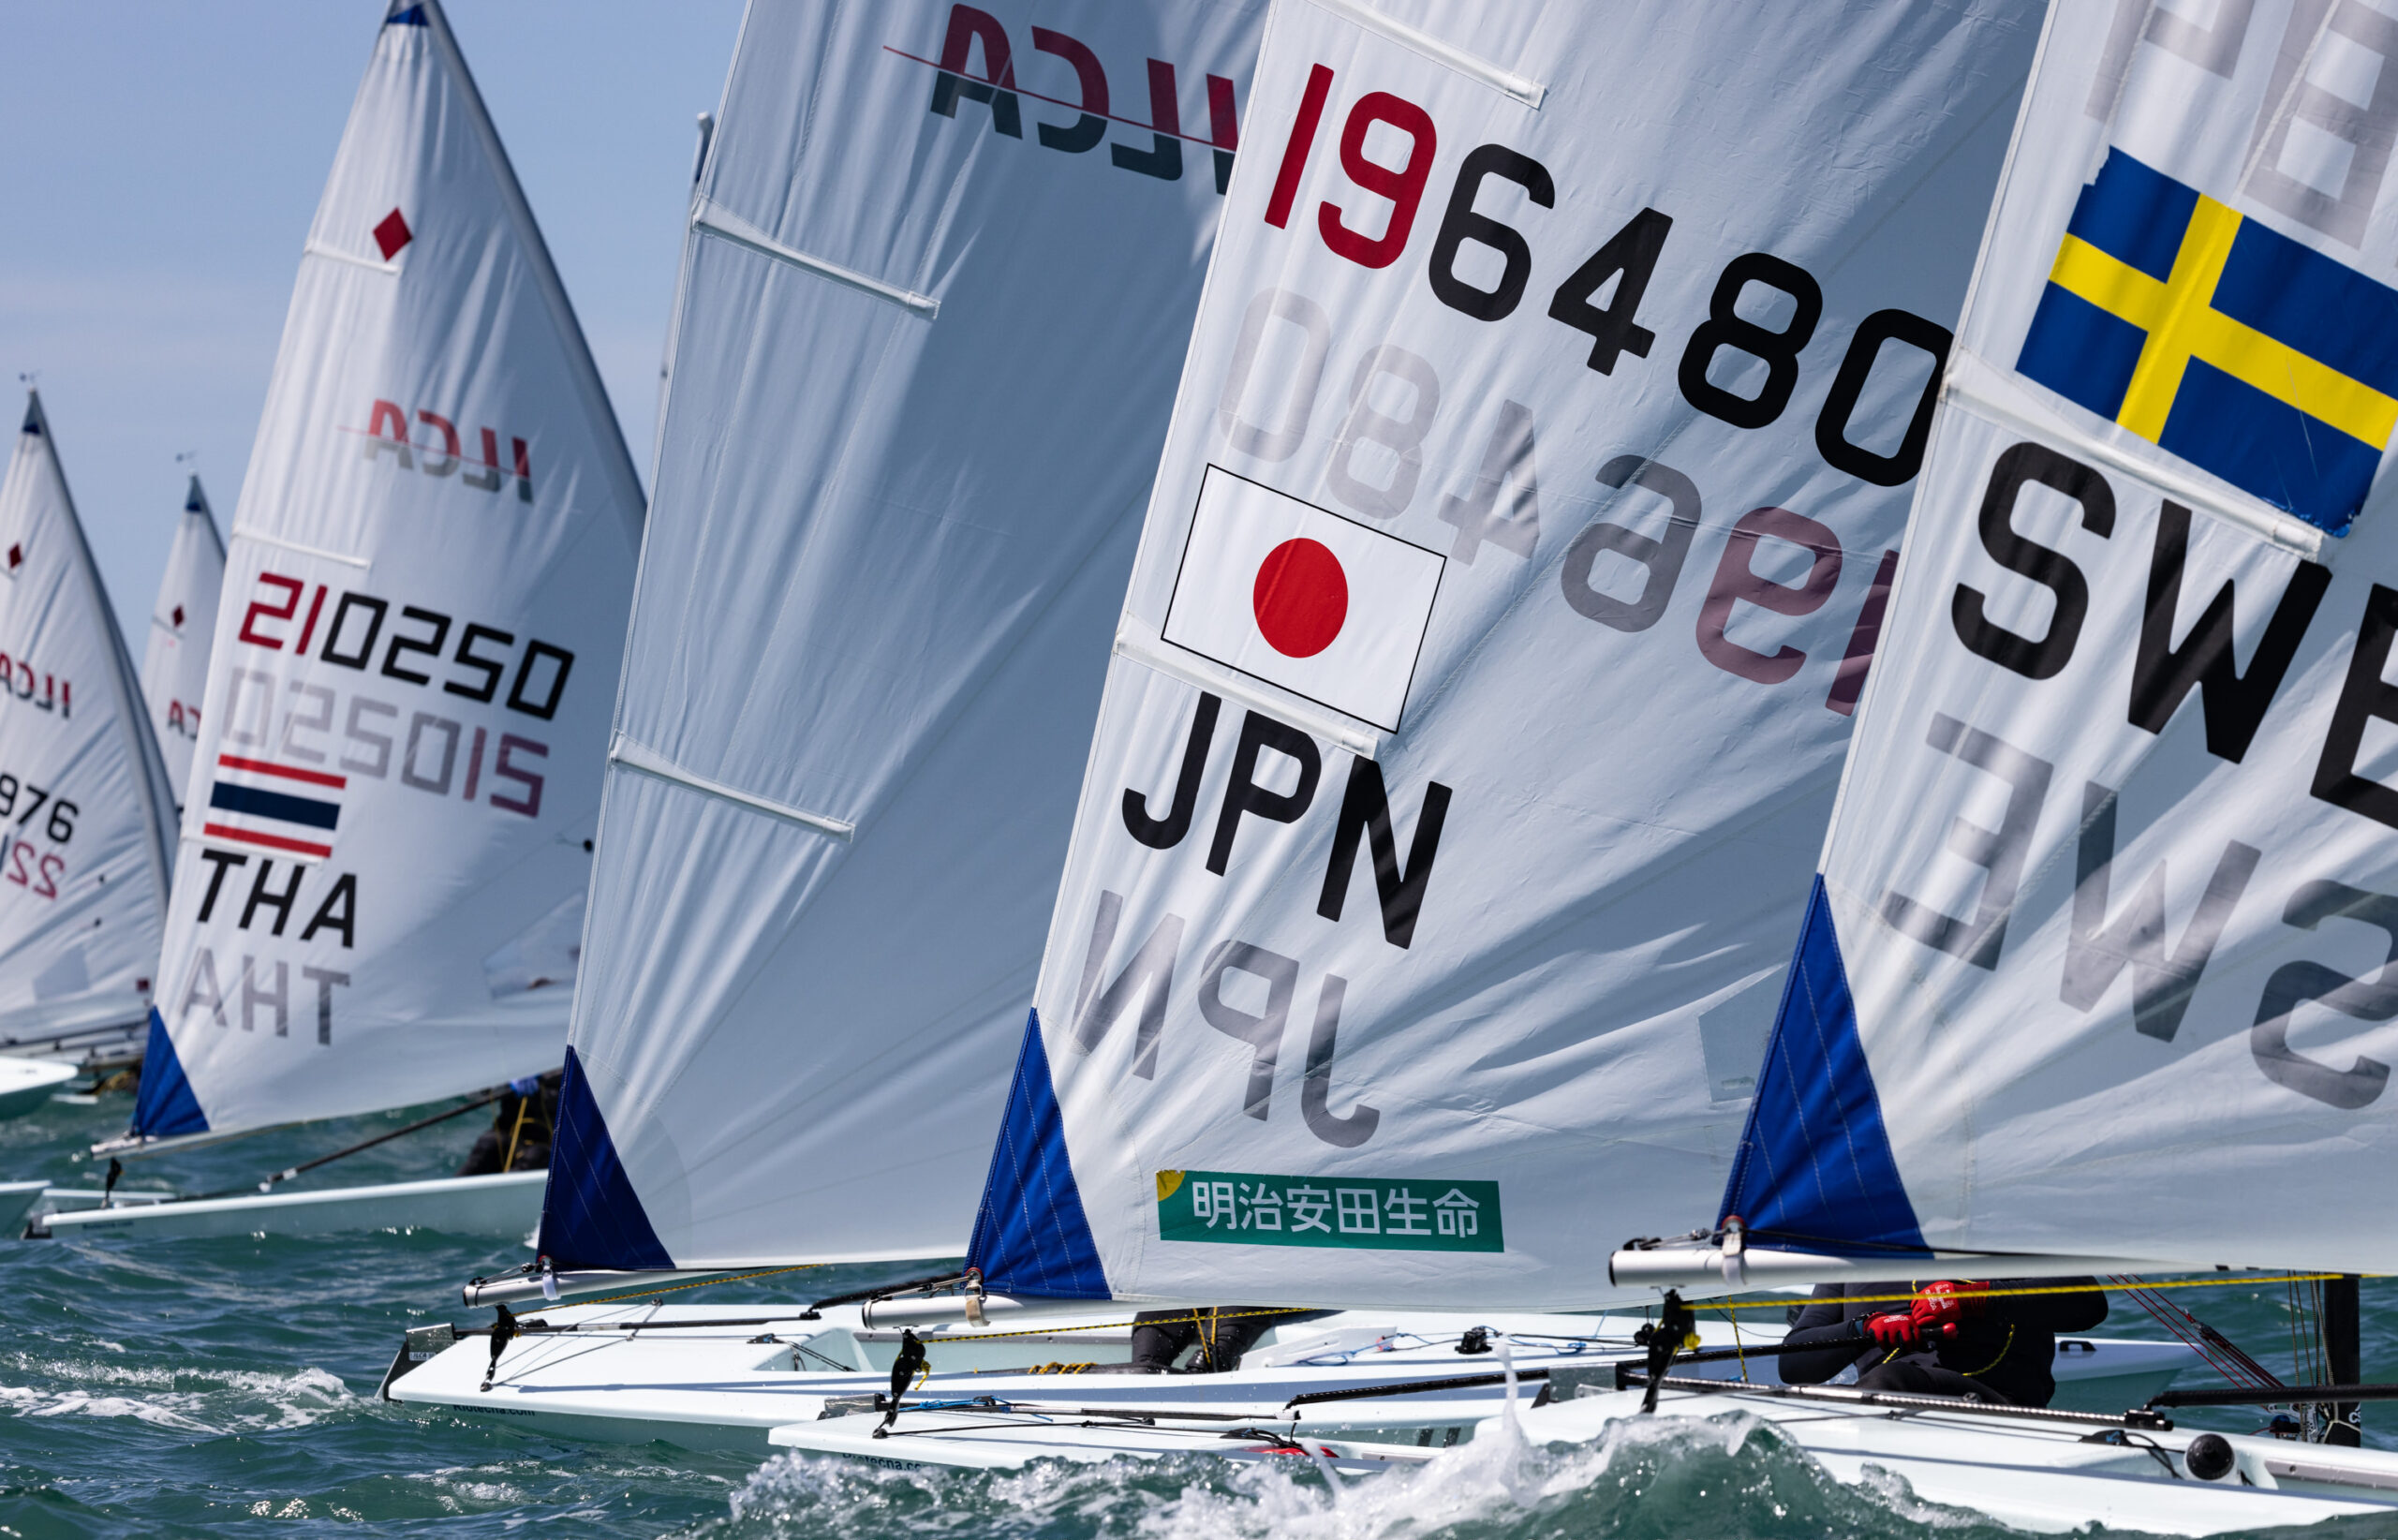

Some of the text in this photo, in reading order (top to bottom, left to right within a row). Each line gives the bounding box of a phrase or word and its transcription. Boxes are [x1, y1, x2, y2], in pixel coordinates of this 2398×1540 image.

[1264, 62, 1956, 488] 196480
[238, 572, 575, 720] 210250
[1951, 441, 2398, 830] SWE
[197, 848, 356, 949] THA
[1122, 691, 1453, 950] JPN
[1192, 1181, 1480, 1238] 明治安田生命
